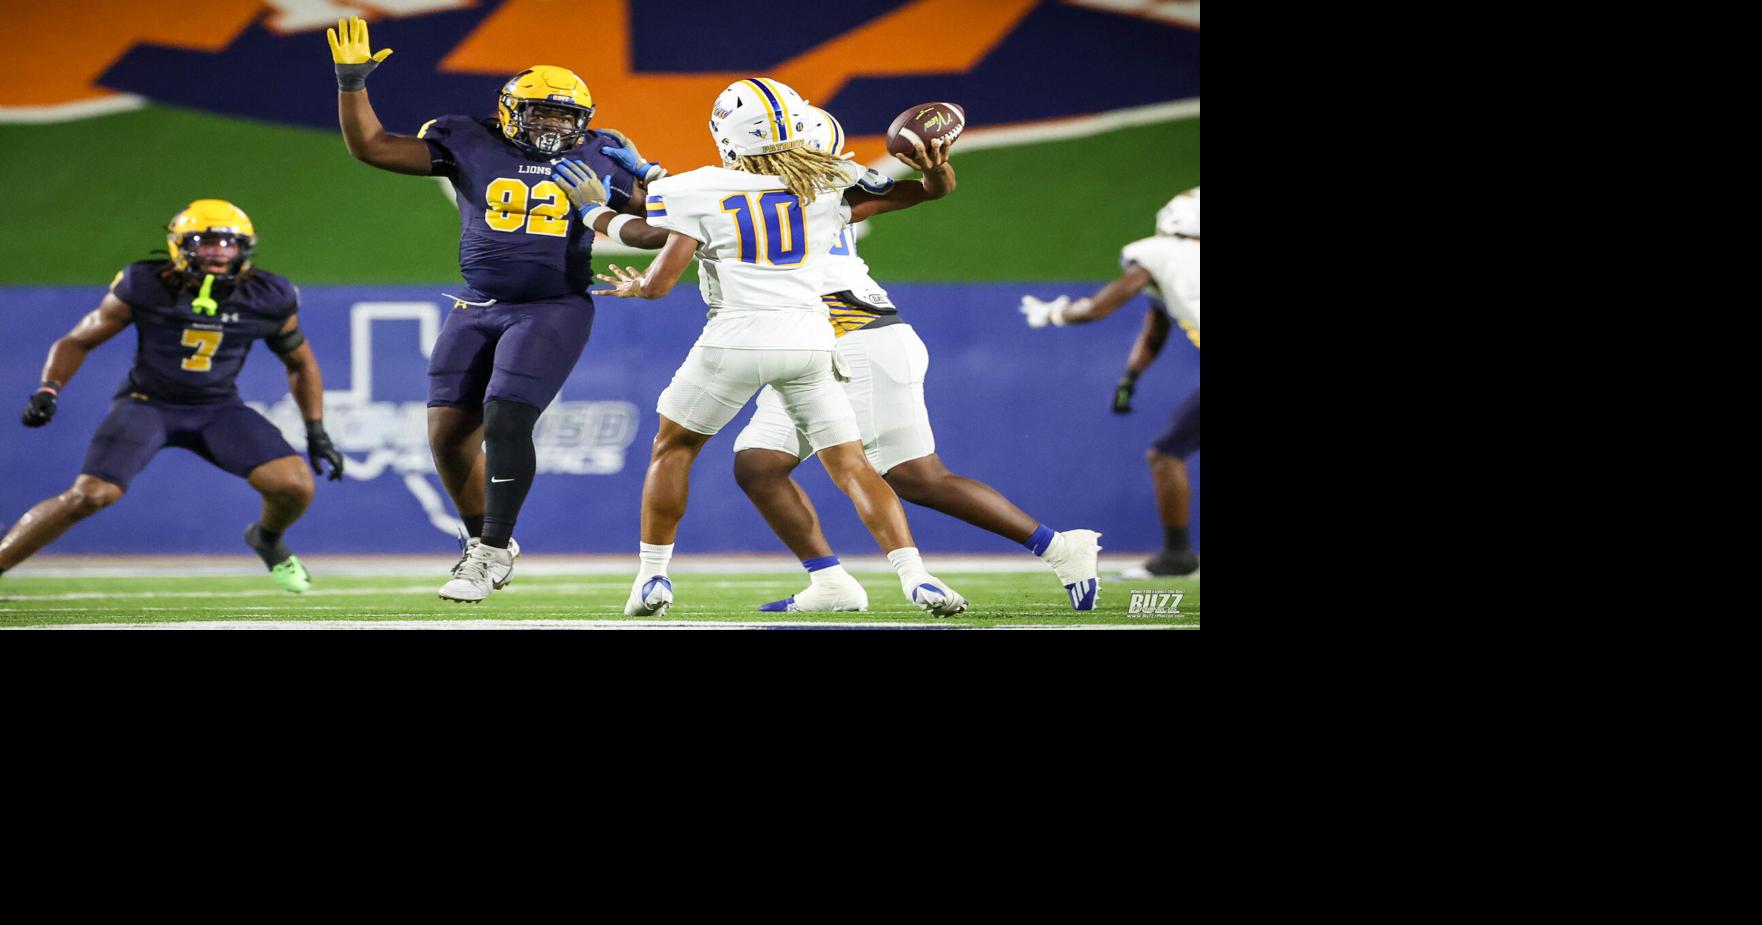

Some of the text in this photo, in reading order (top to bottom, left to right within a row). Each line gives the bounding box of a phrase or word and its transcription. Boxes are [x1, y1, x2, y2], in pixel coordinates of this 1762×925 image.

[518, 164, 552, 176] LIONS
[485, 177, 570, 237] 92
[719, 189, 809, 267] 10
[181, 328, 224, 371] 7
